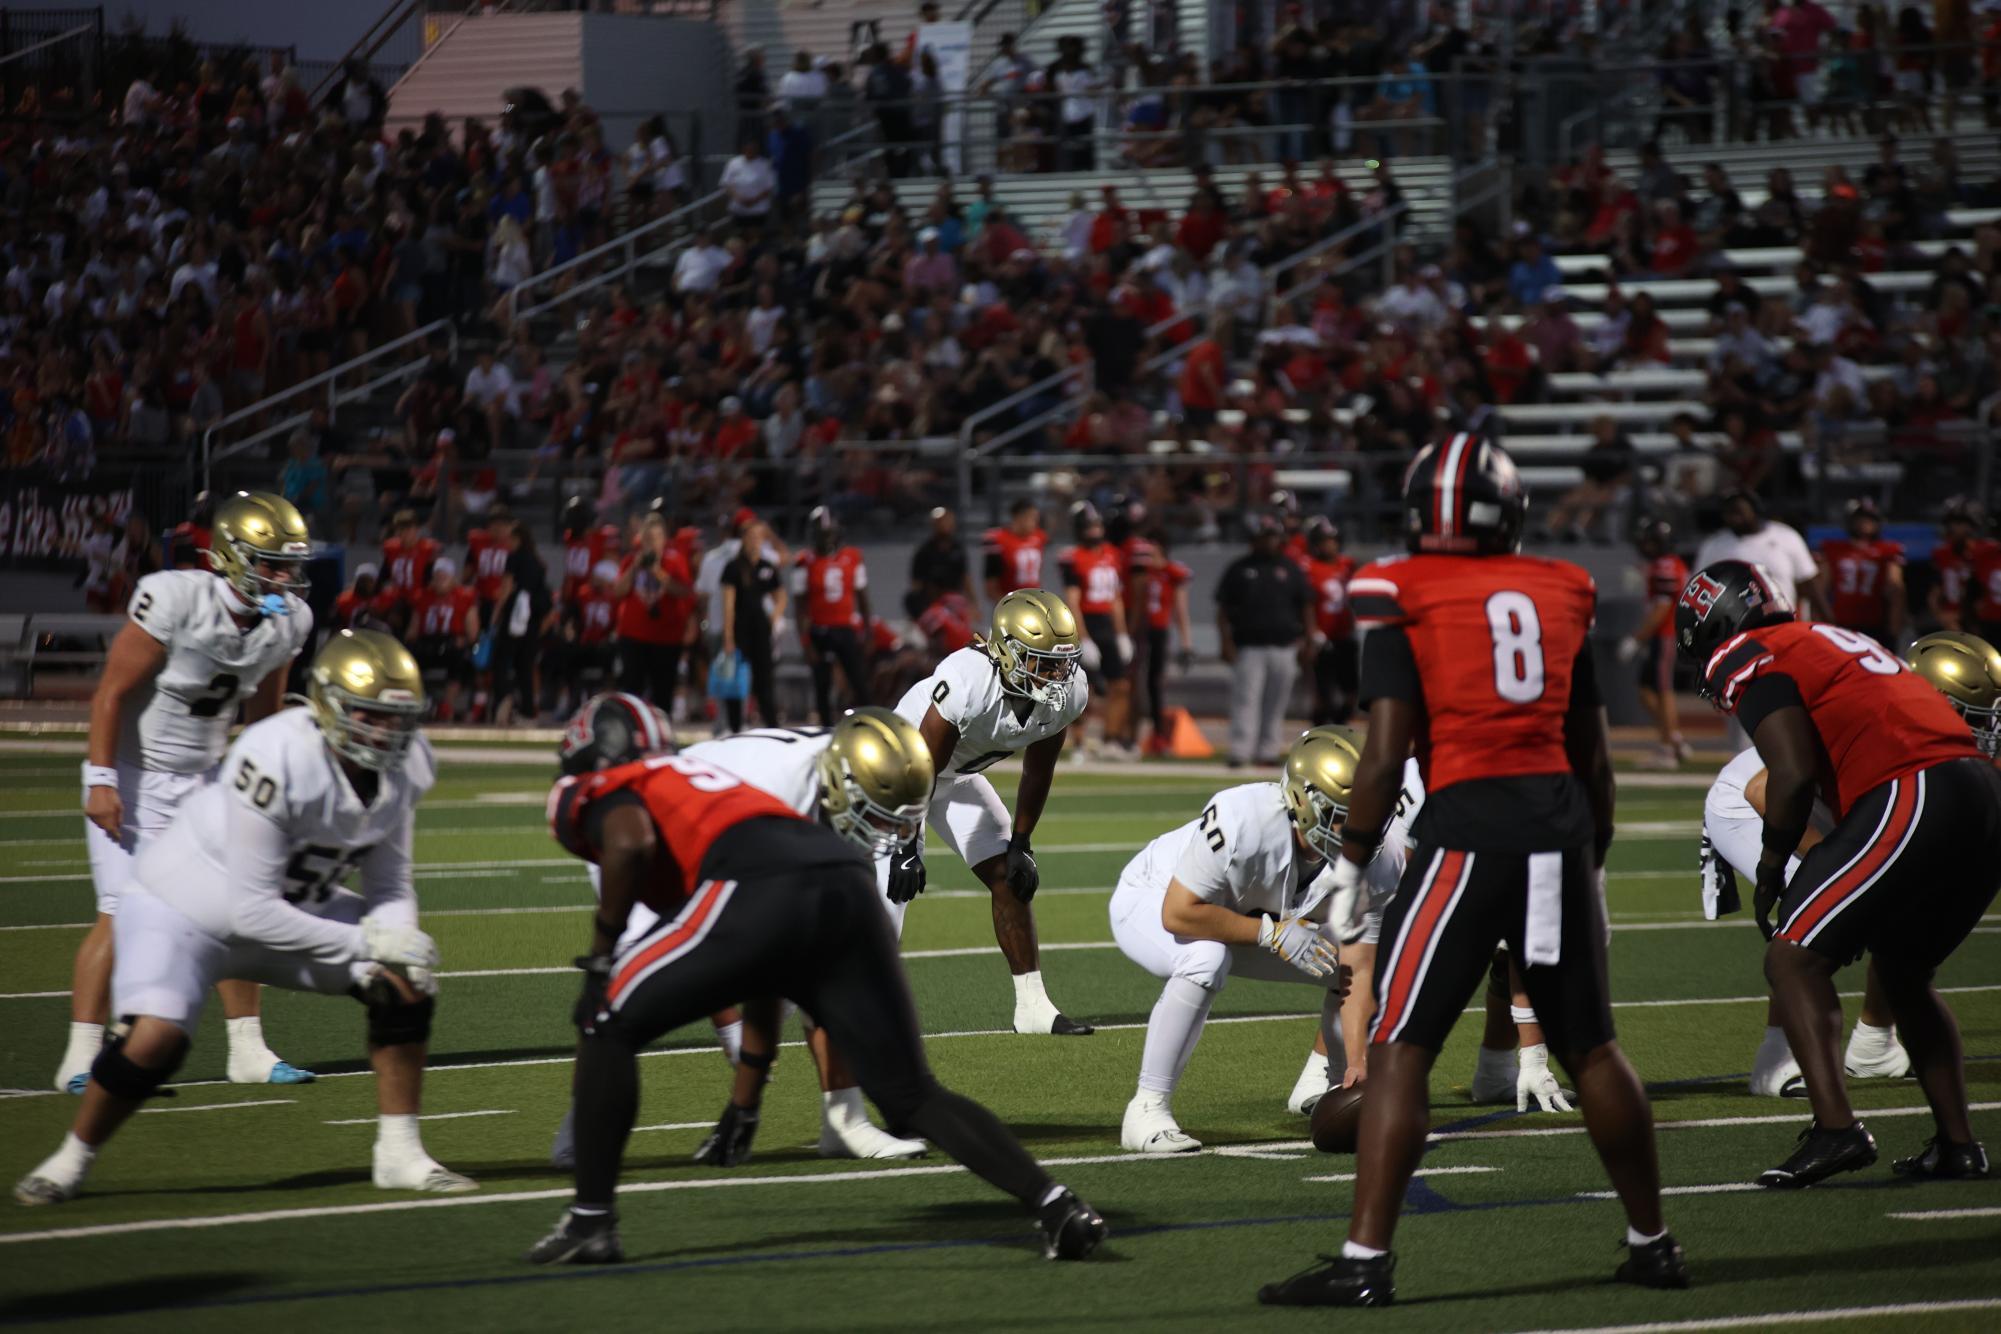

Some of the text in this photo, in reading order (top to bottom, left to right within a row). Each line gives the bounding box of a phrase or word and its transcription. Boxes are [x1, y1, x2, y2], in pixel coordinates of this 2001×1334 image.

[134, 592, 152, 621] 2
[1680, 571, 1726, 622] H
[1484, 590, 1545, 704] 8
[190, 673, 239, 717] 2
[932, 680, 951, 705] 0
[235, 758, 277, 809] 50
